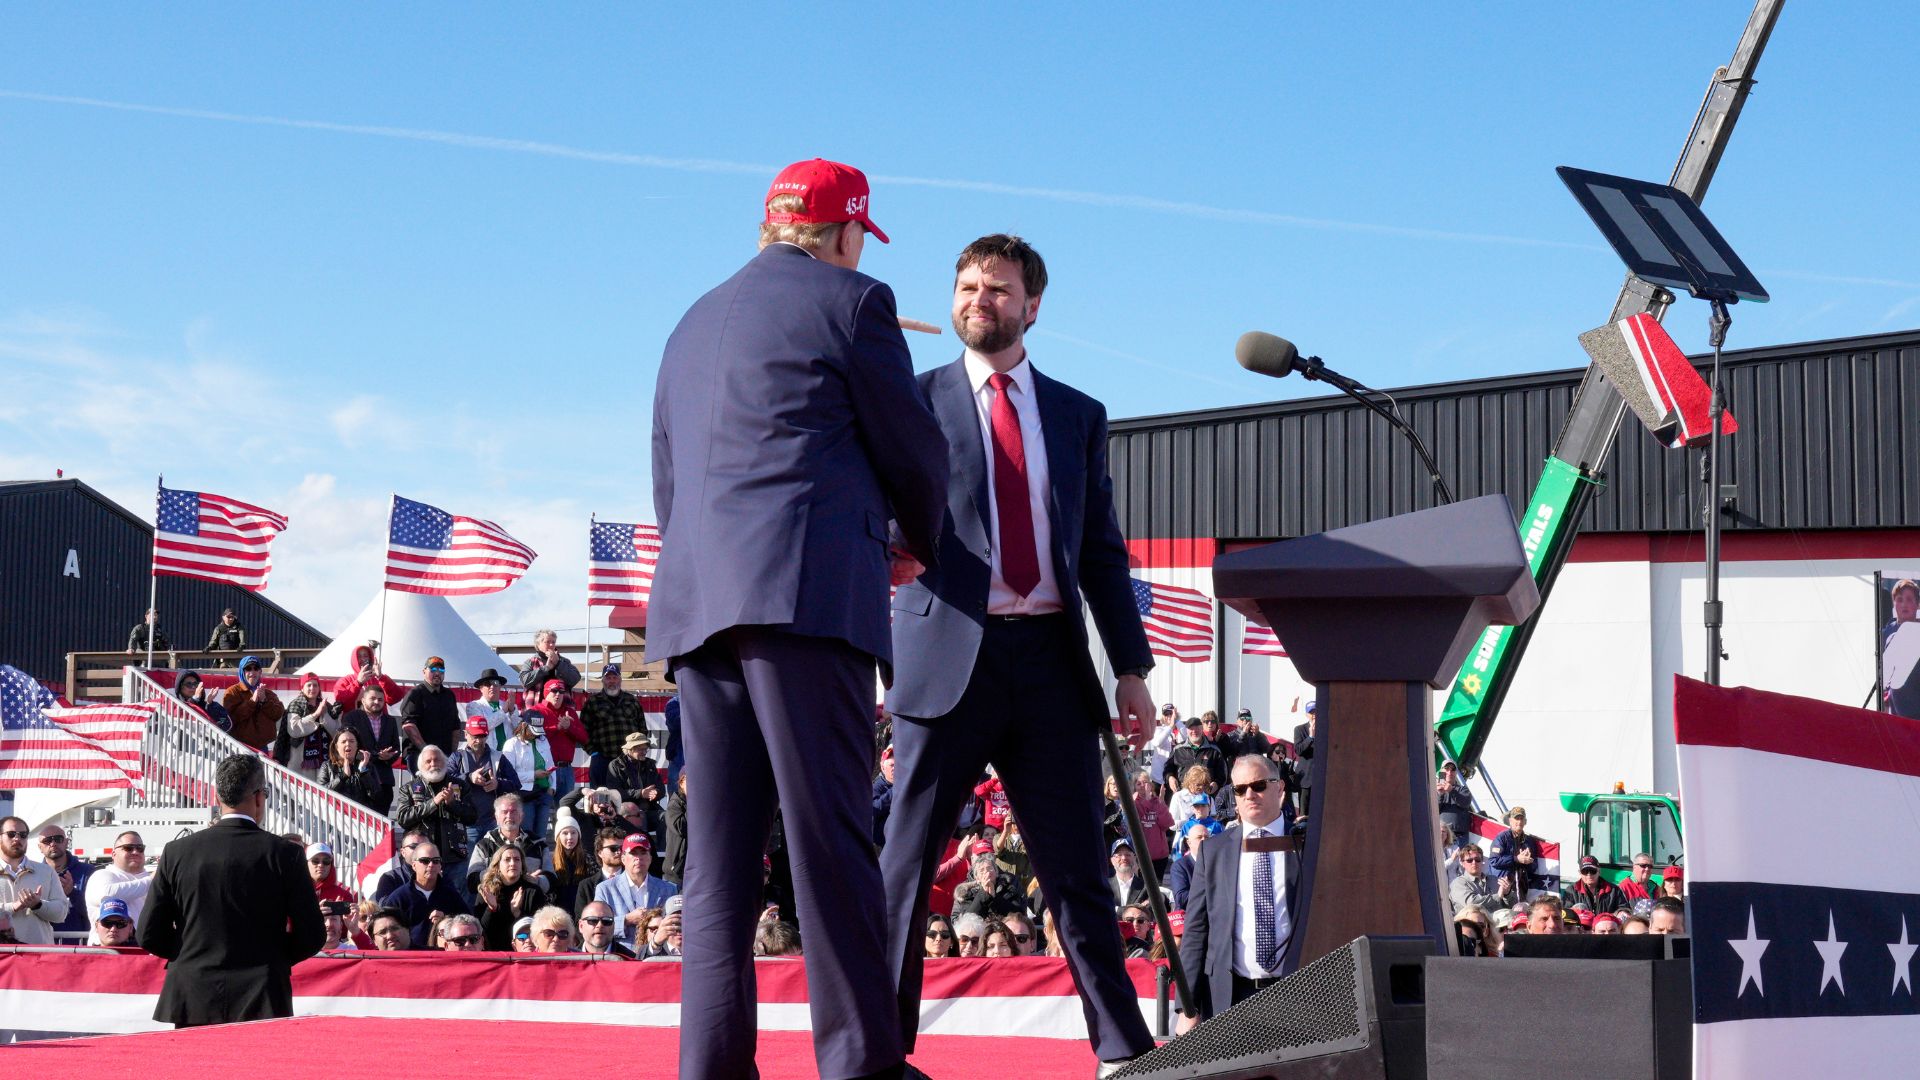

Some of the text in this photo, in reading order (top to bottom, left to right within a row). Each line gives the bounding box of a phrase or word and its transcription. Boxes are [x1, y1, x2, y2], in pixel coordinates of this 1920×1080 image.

[774, 183, 807, 191] TRUMP
[846, 196, 867, 215] 45-47
[1523, 503, 1553, 565] TALS
[63, 549, 80, 578] A
[990, 791, 1008, 800] TRU
[992, 807, 1008, 815] 202
